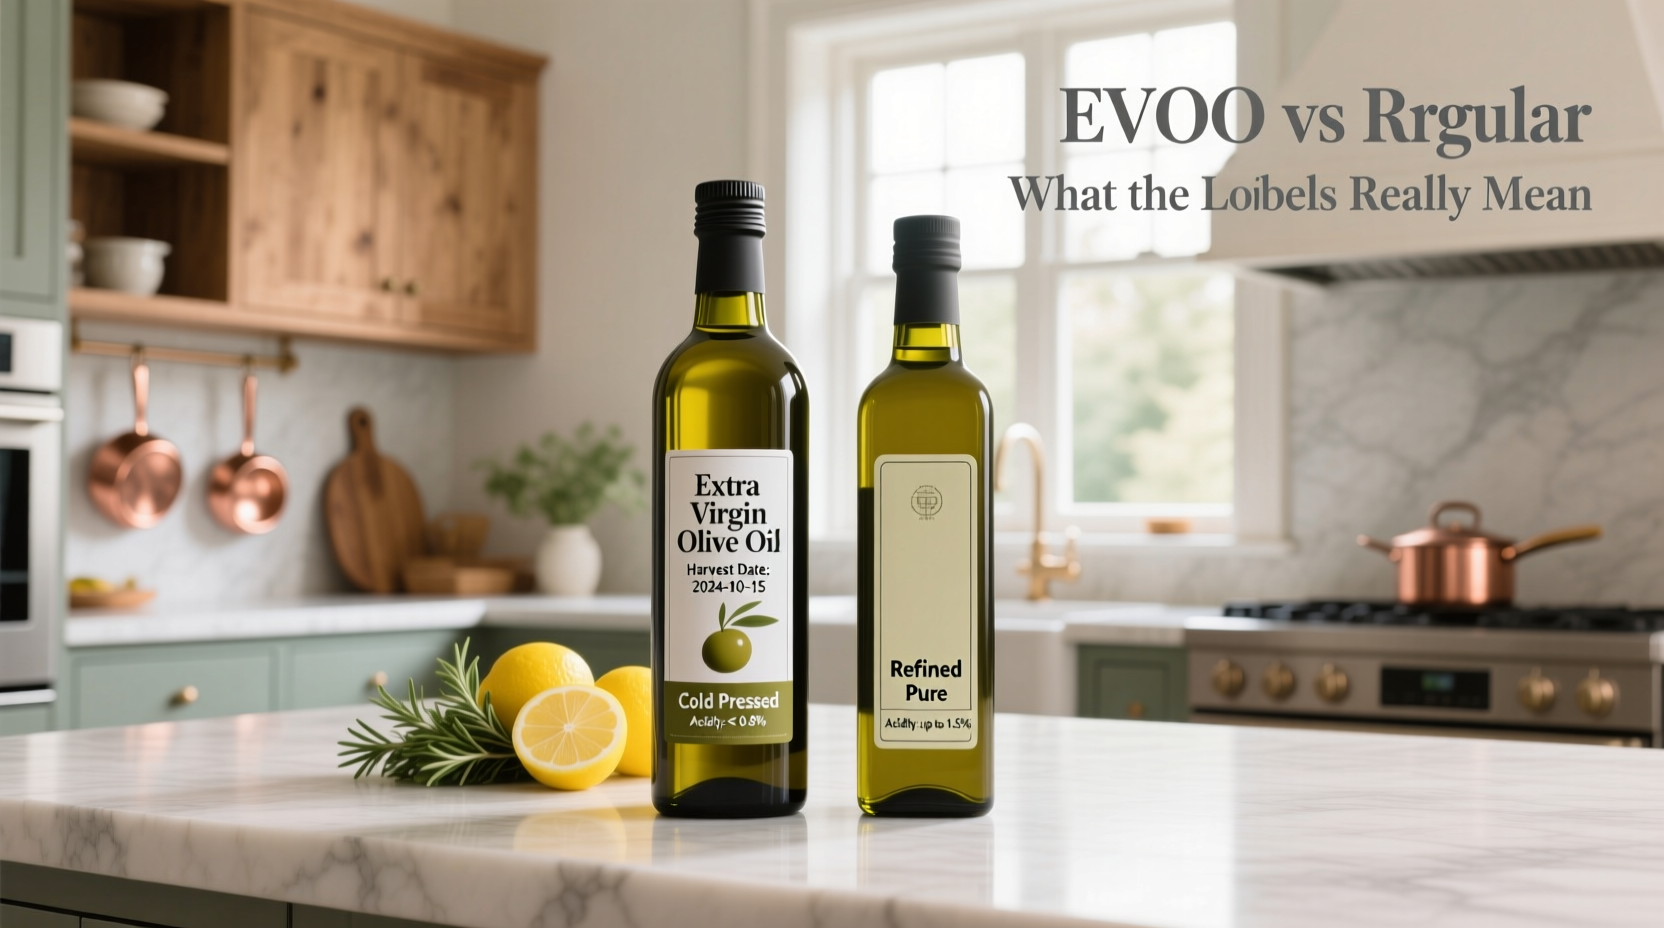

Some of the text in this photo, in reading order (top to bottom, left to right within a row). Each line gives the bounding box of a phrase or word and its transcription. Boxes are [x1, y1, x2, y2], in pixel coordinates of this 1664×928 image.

[694, 473, 760, 497] Extra
[690, 501, 767, 532] Virgin
[677, 528, 781, 553] Olive Oil
[687, 563, 770, 576] Harvest Date:
[692, 580, 766, 594] 2024-10-15
[890, 658, 962, 678] Refined
[678, 690, 780, 710] Cold Pressed
[906, 684, 948, 702] Pure
